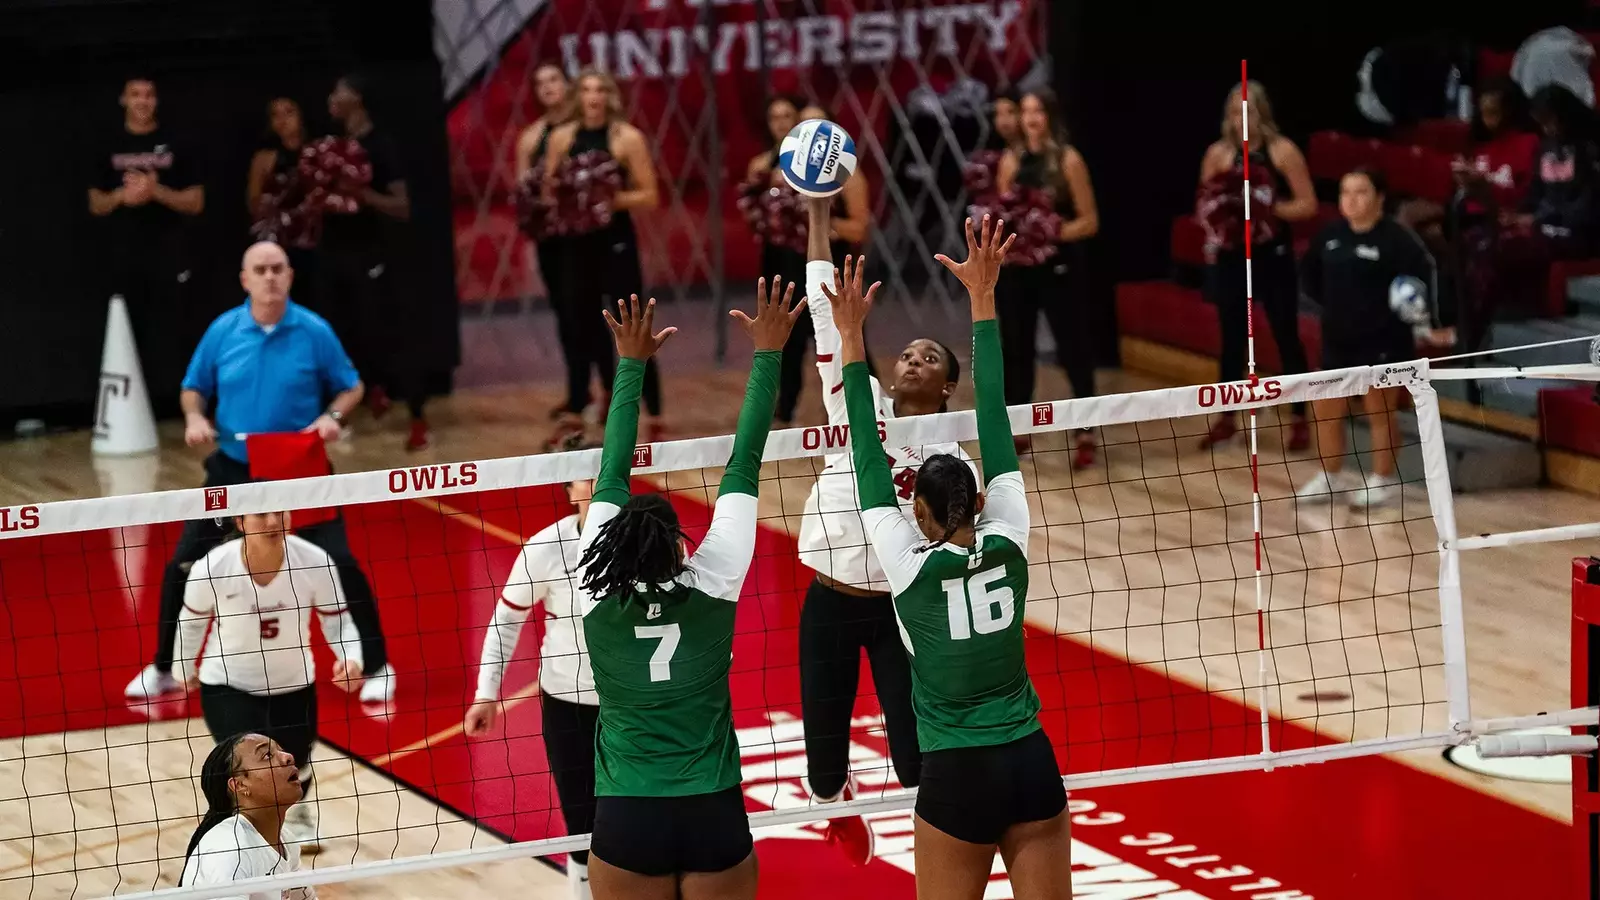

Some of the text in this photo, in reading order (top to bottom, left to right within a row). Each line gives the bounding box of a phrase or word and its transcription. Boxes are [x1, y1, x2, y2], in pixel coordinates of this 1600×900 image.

[558, 1, 1021, 79] UNIVERSITY
[823, 132, 841, 176] molten
[1392, 365, 1416, 374] Senoh
[1198, 380, 1282, 407] OWLS
[802, 420, 888, 451] OWS
[388, 462, 478, 494] OWLS
[0, 505, 40, 532] LS
[941, 563, 1015, 640] 16
[259, 617, 280, 640] 5
[634, 622, 681, 682] 7
